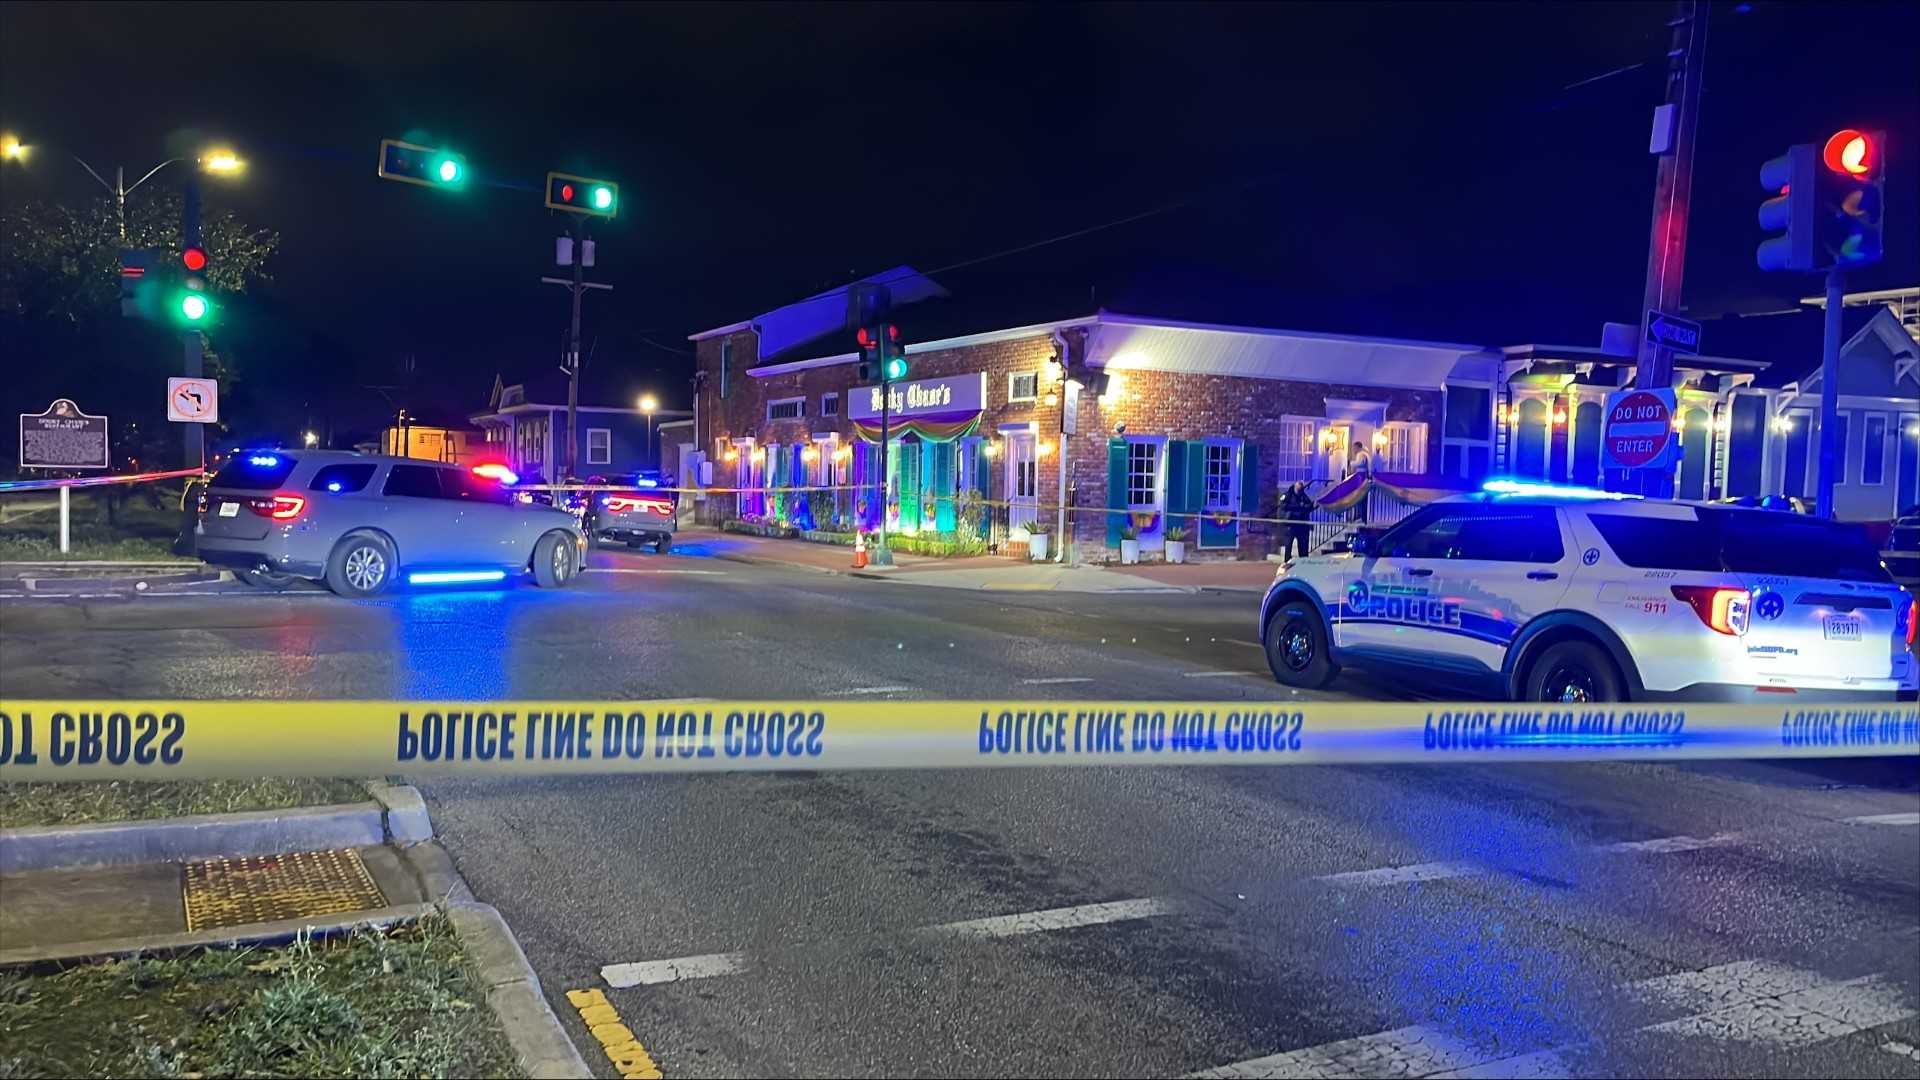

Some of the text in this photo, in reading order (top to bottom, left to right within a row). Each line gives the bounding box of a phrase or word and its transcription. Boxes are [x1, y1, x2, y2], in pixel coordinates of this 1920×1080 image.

[1615, 405, 1662, 420] DO NOT
[1616, 439, 1654, 453] ENTER
[1369, 593, 1460, 625] POLICE
[1644, 602, 1667, 614] 911
